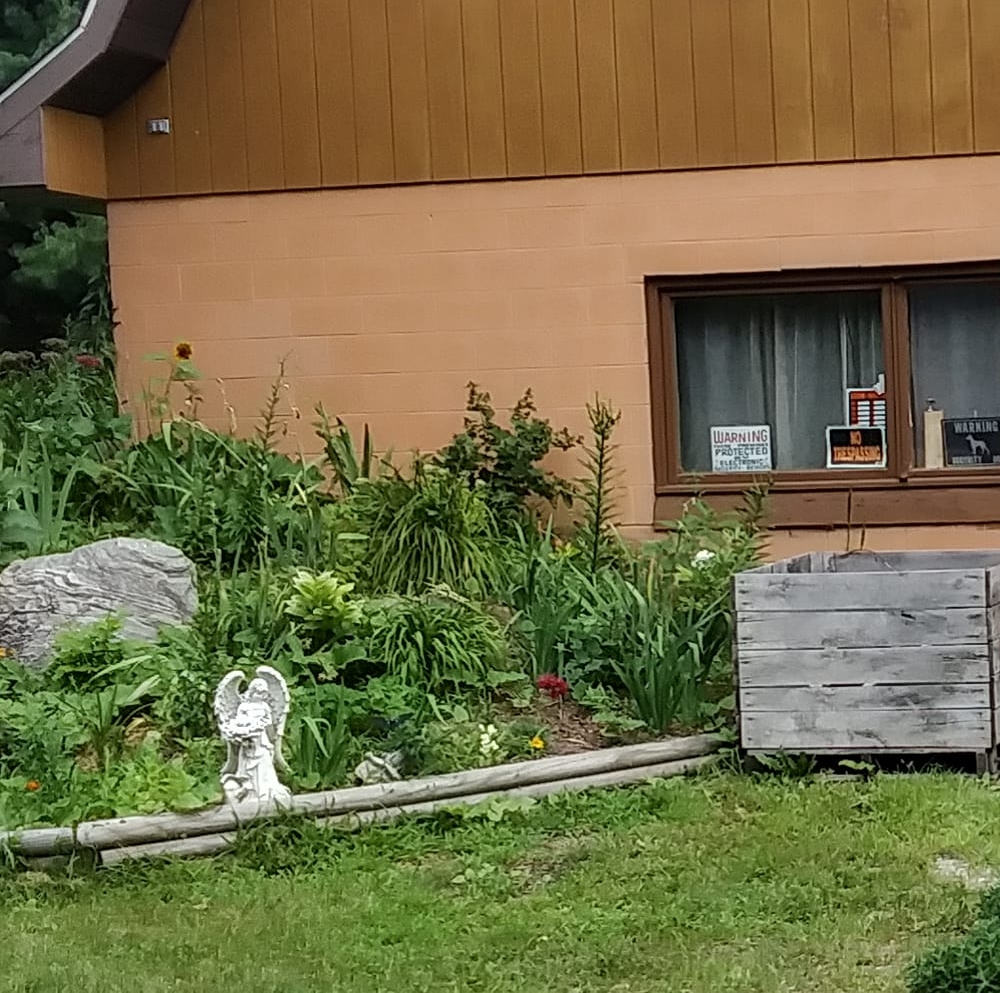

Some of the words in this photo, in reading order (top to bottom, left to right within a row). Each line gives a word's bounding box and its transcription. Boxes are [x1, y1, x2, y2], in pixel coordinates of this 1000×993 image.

[953, 420, 999, 434] WARNING
[713, 429, 769, 444] WARNING
[714, 446, 769, 456] PROTECTED
